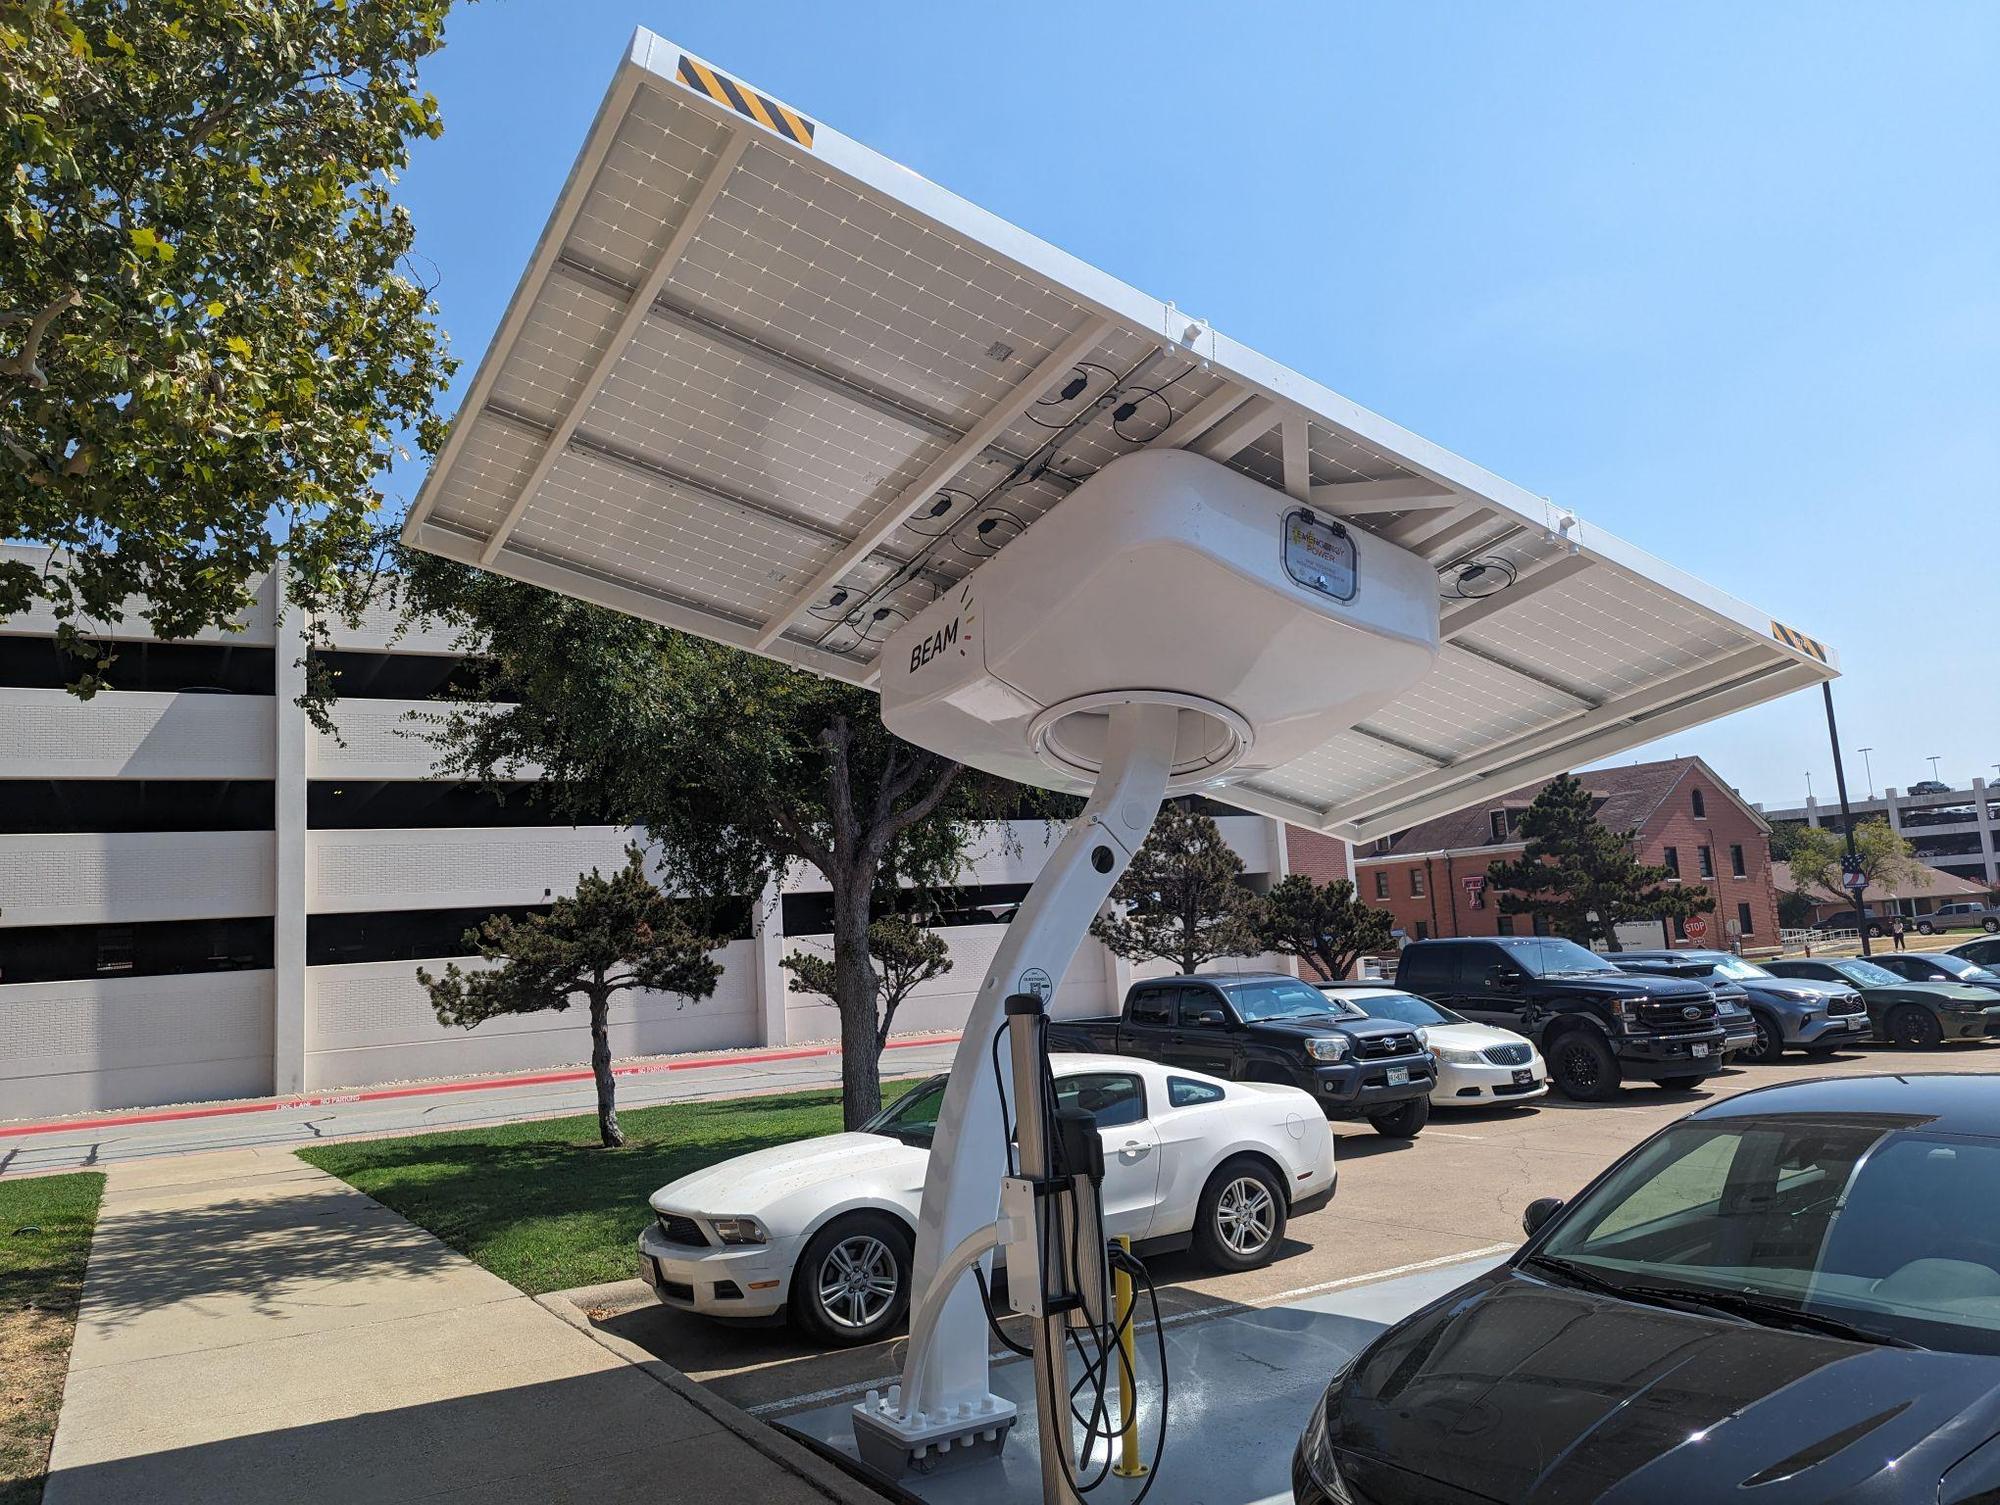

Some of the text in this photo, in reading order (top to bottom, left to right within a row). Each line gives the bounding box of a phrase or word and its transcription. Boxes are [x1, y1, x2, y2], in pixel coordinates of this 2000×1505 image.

[1306, 543, 1336, 562] POWER
[910, 617, 959, 673] BEAM
[1685, 921, 1705, 932] STOP
[331, 1094, 360, 1103] PARKING
